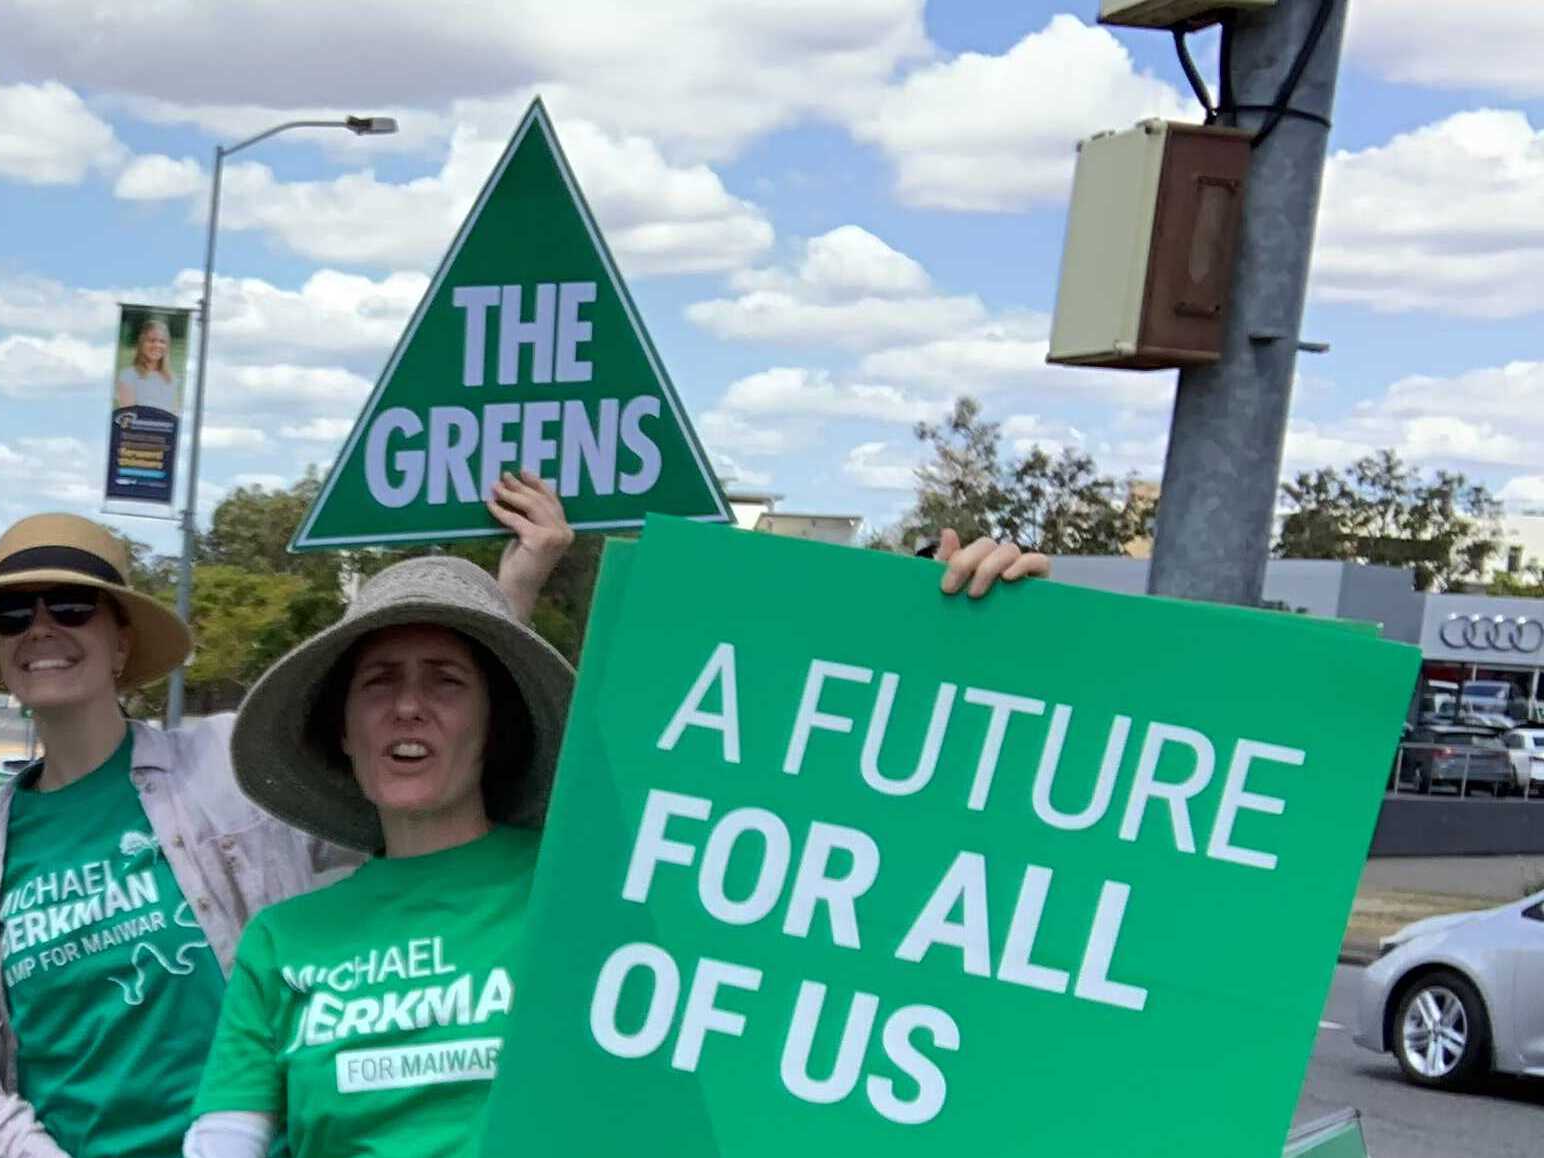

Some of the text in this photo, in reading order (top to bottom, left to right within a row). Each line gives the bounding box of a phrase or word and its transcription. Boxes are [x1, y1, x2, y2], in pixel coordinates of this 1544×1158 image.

[453, 281, 597, 387] THE
[364, 394, 662, 508] GREENS
[657, 642, 1305, 870] A FUTURE
[2, 871, 159, 960] ERKMAN
[39, 942, 81, 971] FOR
[80, 911, 167, 955] MAIWAR
[621, 789, 1148, 1011] FOR ALL
[285, 967, 514, 1054] ERKMA
[589, 942, 960, 1124] OF US
[347, 1055, 395, 1084] FOR
